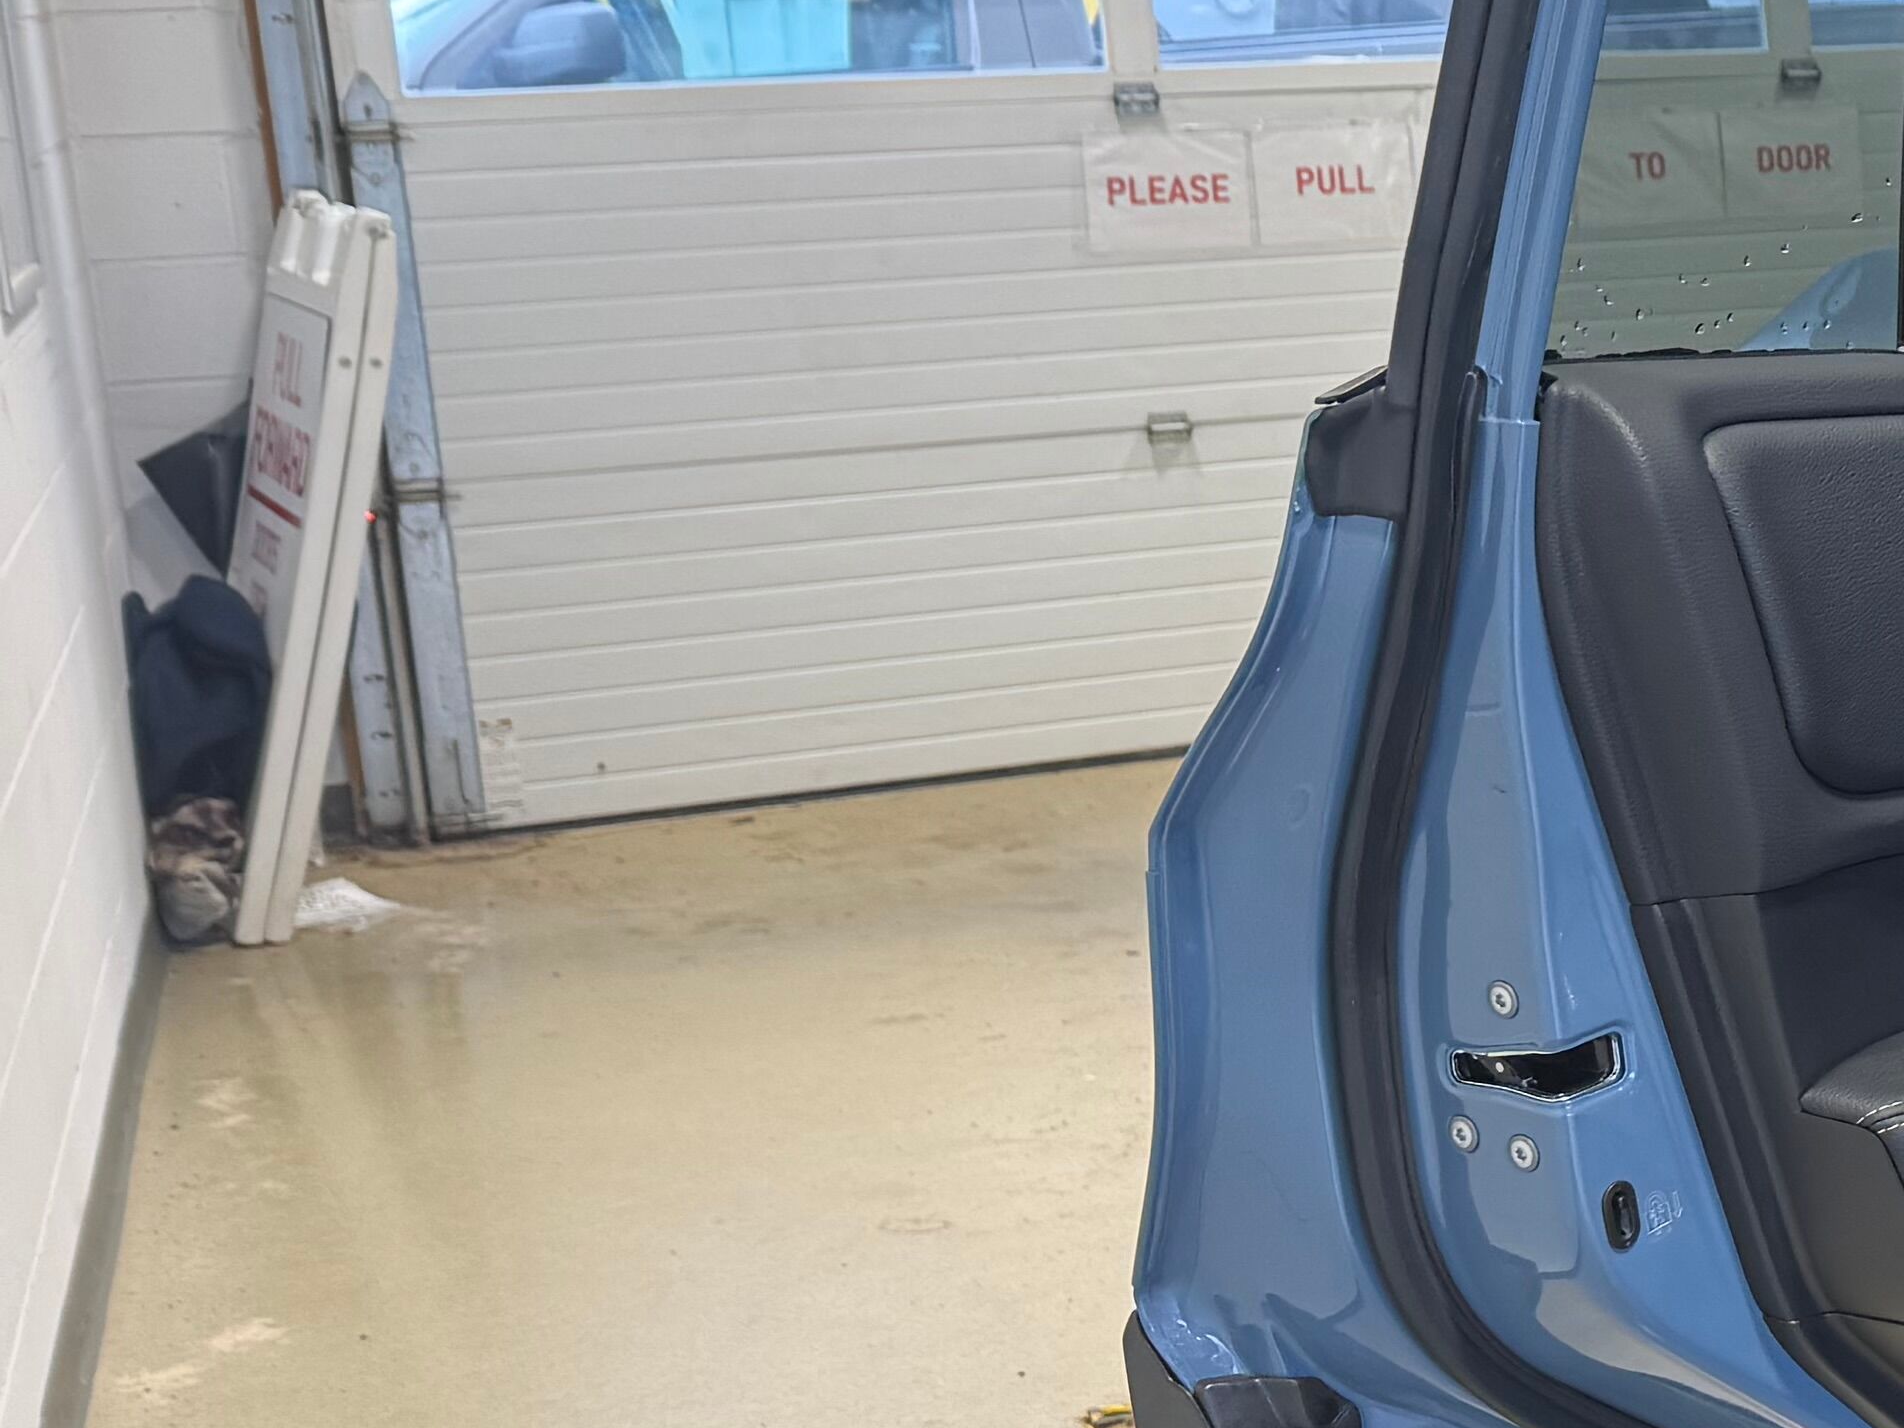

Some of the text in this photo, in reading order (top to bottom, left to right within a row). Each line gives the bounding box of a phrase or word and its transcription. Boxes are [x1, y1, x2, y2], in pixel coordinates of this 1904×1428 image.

[1106, 143, 1831, 206] PLEASE PULL TO DOOR
